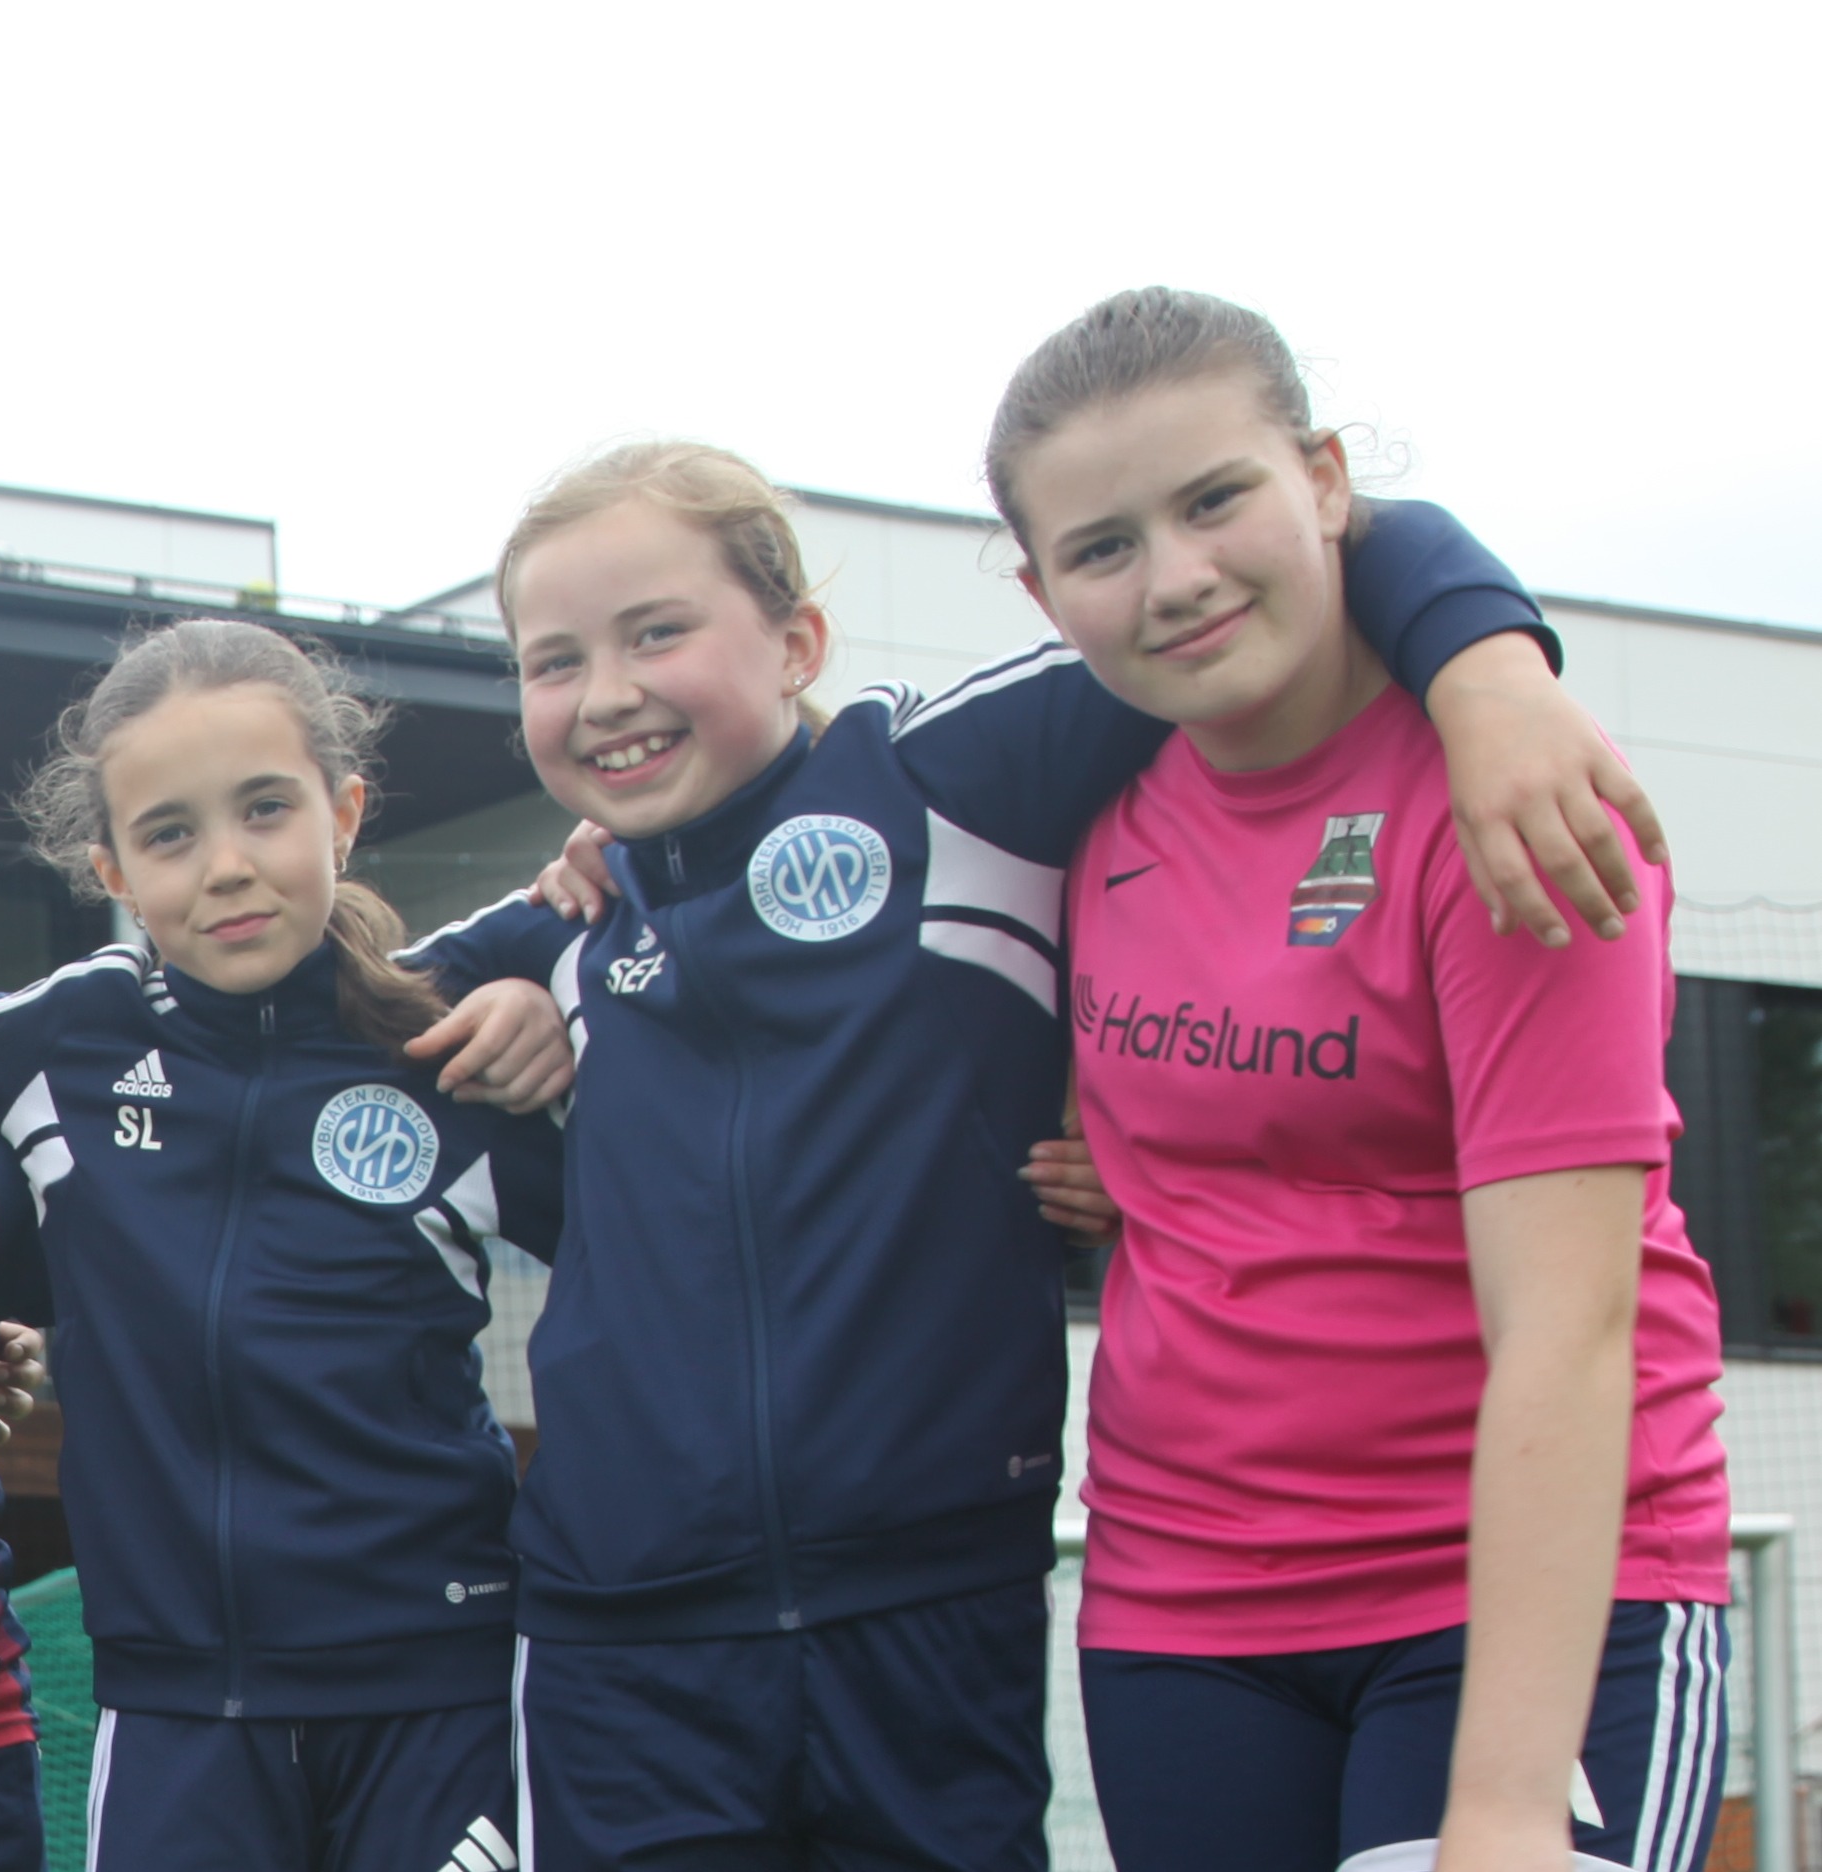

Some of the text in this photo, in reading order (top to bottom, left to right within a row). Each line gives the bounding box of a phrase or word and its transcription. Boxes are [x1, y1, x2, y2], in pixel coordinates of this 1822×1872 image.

[783, 818, 813, 835] OG
[821, 816, 887, 877] STOVNER
[819, 913, 860, 935] 1916
[1098, 992, 1360, 1080] Hafslund
[112, 1080, 173, 1098] adidas
[114, 1105, 162, 1151] SL
[373, 1087, 399, 1106] OG
[402, 1102, 436, 1183] STOVNER
[349, 1184, 386, 1201] 1916
